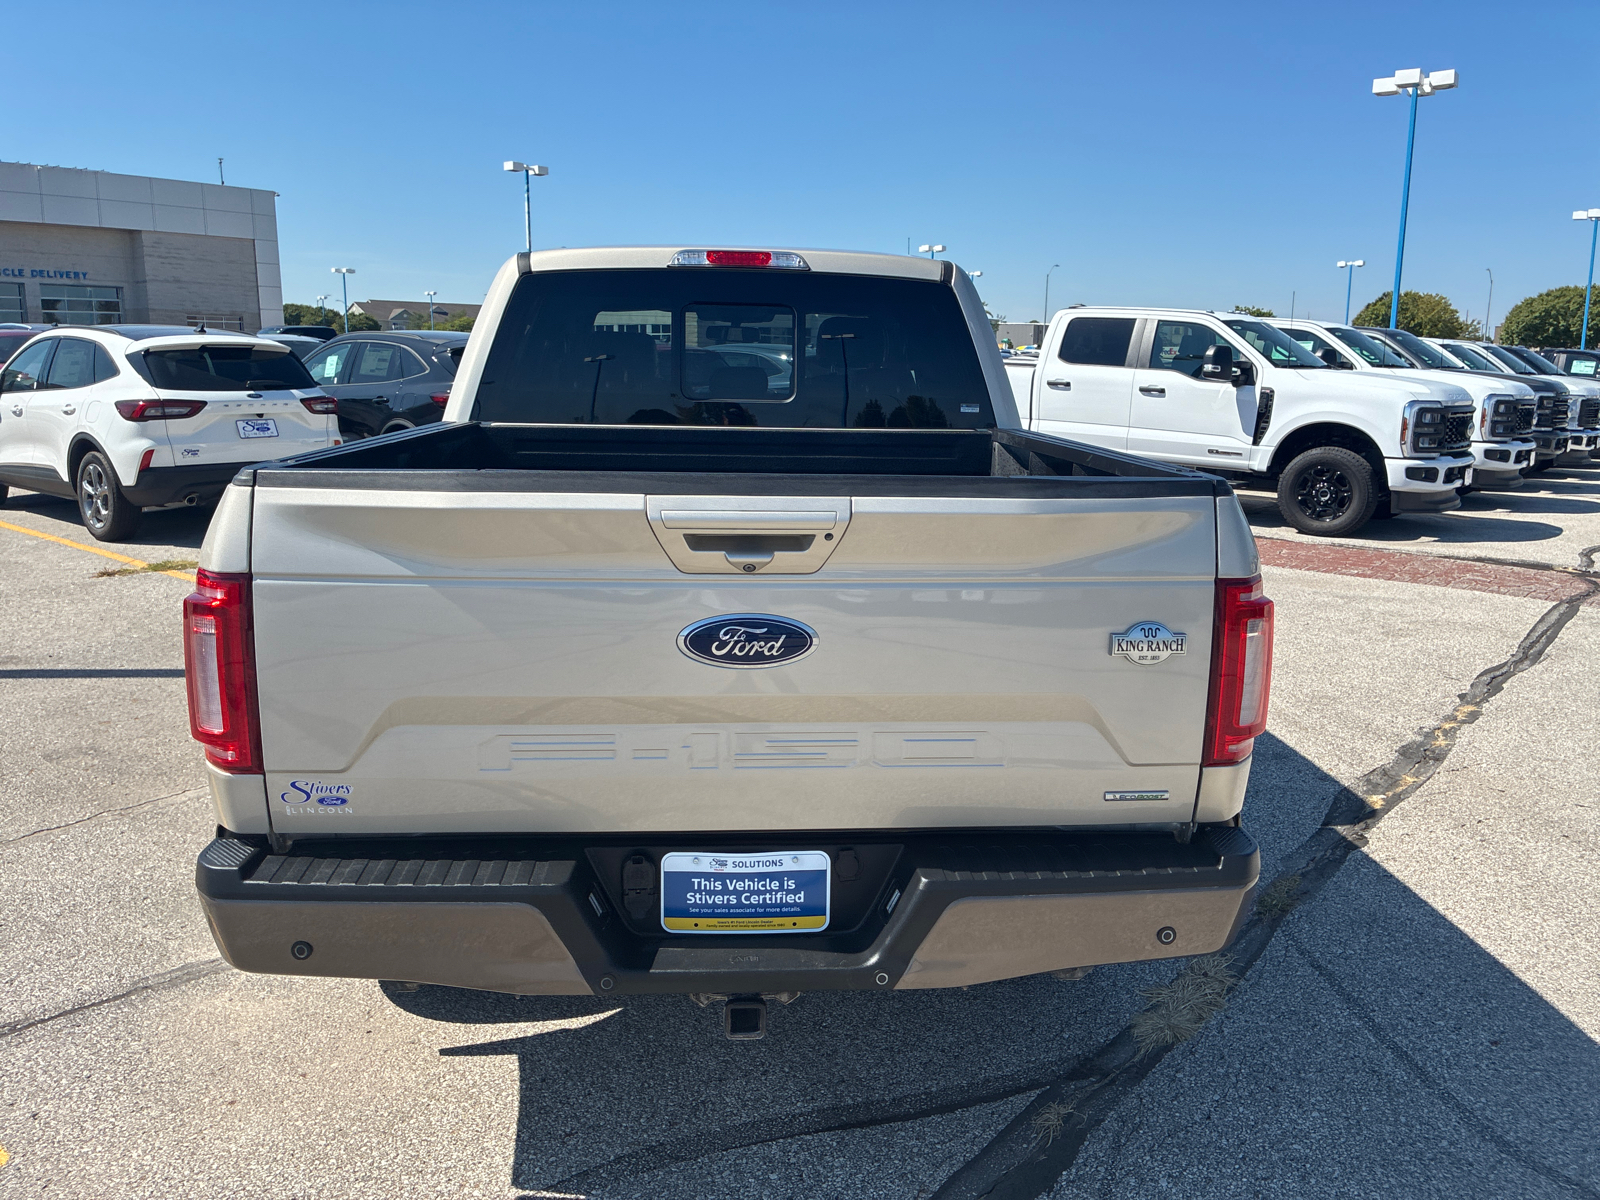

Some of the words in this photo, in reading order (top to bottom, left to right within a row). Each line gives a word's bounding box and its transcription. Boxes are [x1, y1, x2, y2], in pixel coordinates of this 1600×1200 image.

[31, 269, 88, 280] DELIVERY
[712, 626, 786, 655] Ford
[1117, 639, 1143, 652] KING
[1147, 638, 1184, 652] RANCH
[478, 731, 1005, 771] F-150
[280, 780, 352, 804] Stivers
[732, 859, 783, 868] SOLUTIONS
[692, 878, 722, 890] This
[726, 878, 779, 891] Vehicle
[784, 877, 795, 889] is
[686, 892, 737, 904] Stivers
[741, 891, 804, 904] Certified
